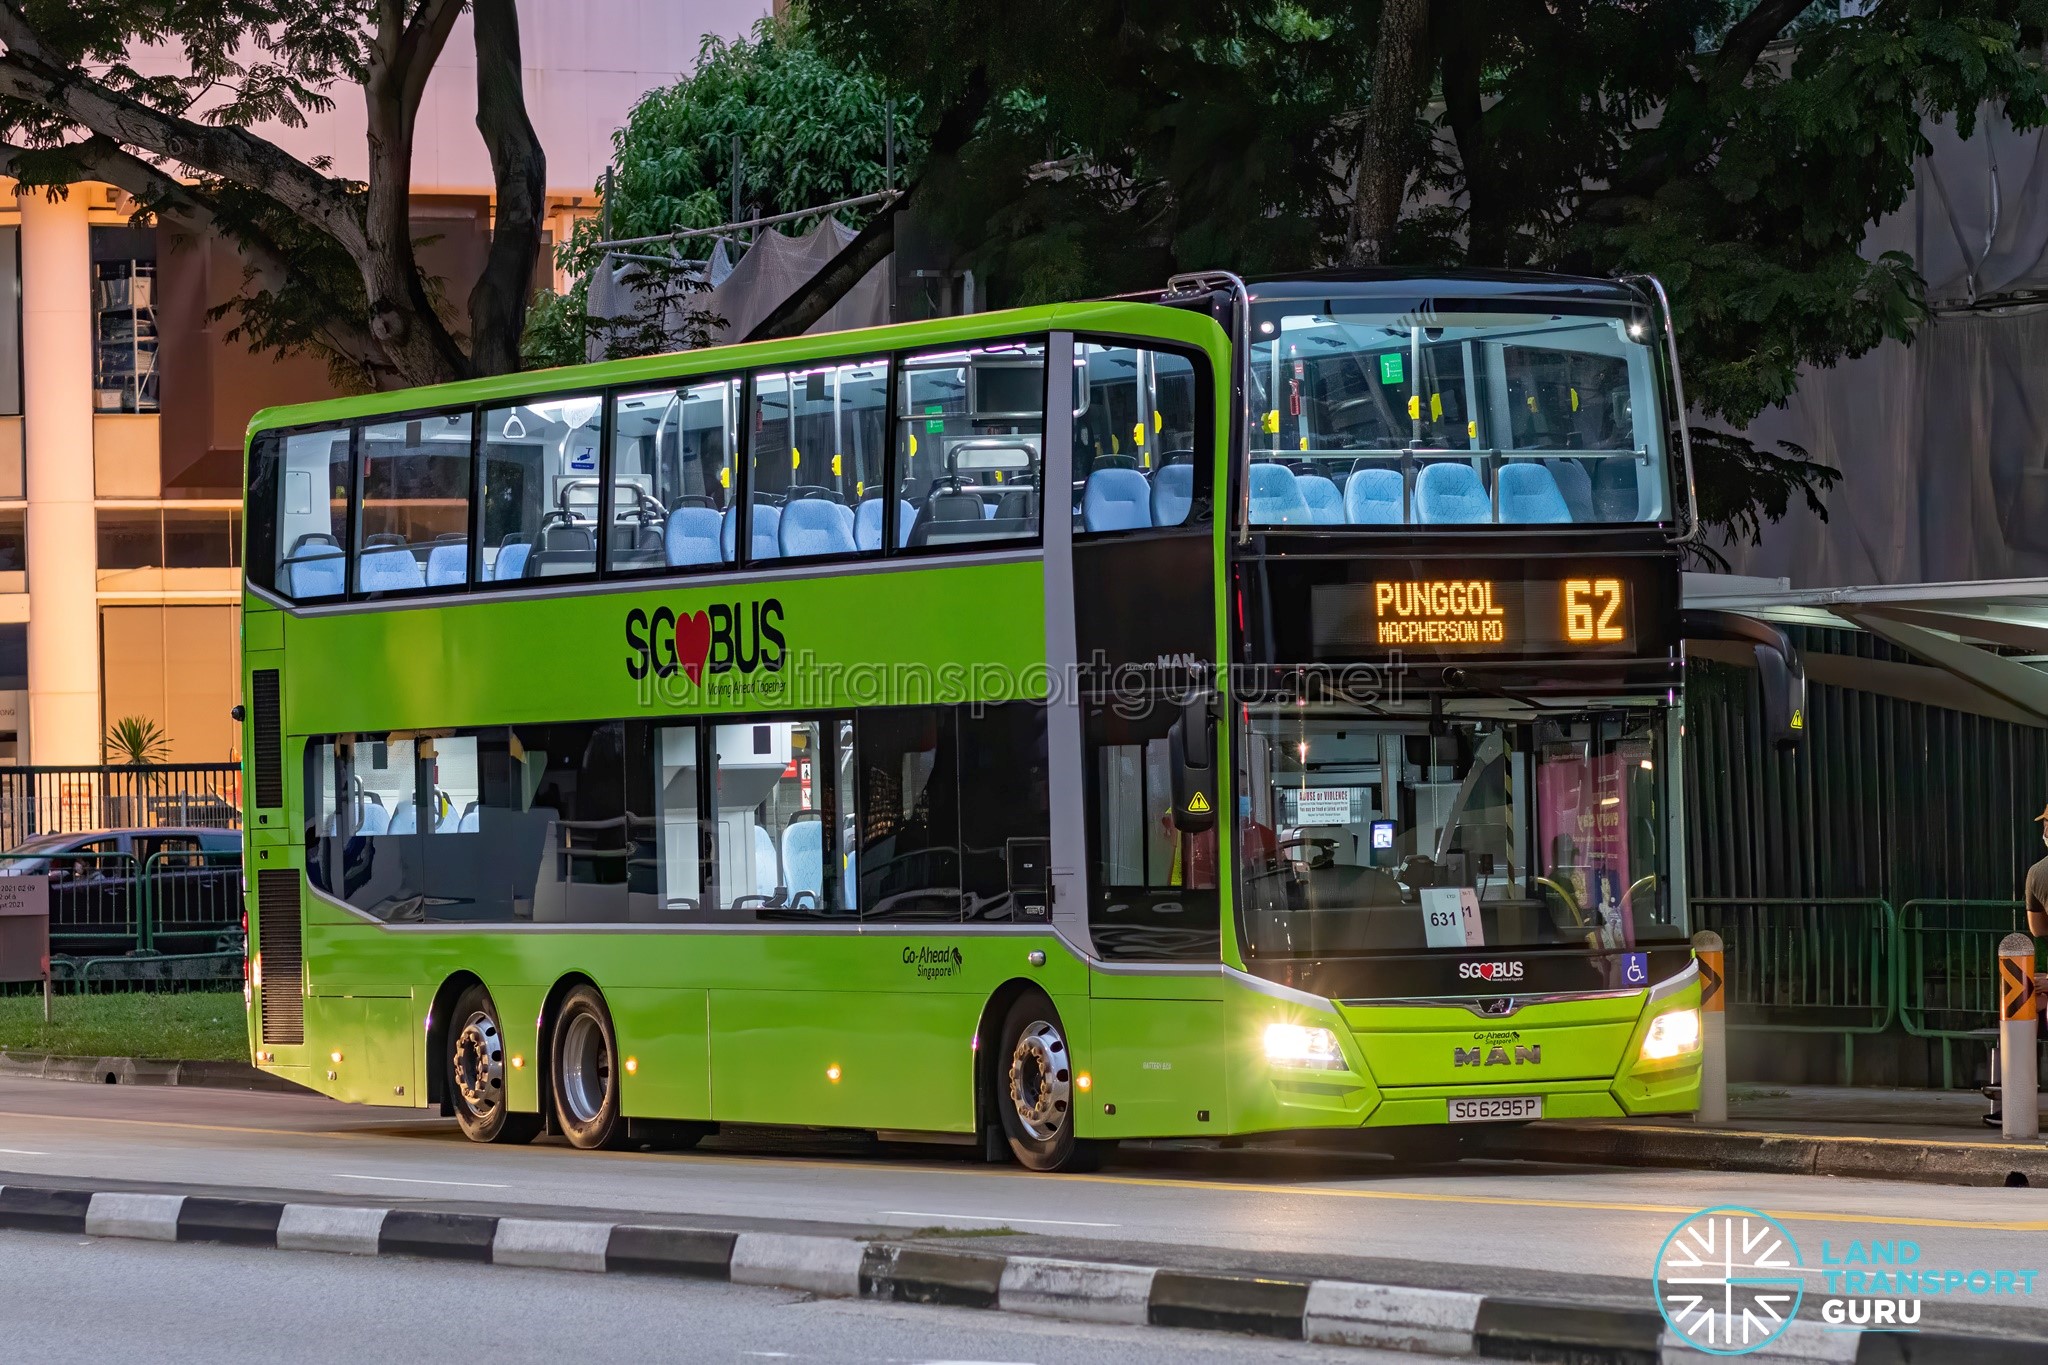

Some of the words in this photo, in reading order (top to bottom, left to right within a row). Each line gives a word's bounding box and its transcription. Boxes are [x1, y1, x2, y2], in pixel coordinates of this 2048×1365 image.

[1376, 581, 1504, 616] PUNGGOL
[1565, 580, 1624, 640] 62
[1378, 621, 1479, 643] MACPHERSON
[1482, 620, 1503, 641] RD
[1157, 652, 1195, 669] MAN
[707, 683, 732, 697] Moving
[733, 680, 755, 694] Ahead
[757, 679, 786, 696] Together
[1323, 791, 1348, 800] VIOLENCE
[1430, 912, 1457, 927] 631
[902, 946, 951, 964] Go-Ahead
[917, 964, 952, 980] Singapore
[1473, 1031, 1510, 1040] Go-Ahead
[1454, 1044, 1541, 1068] MAN
